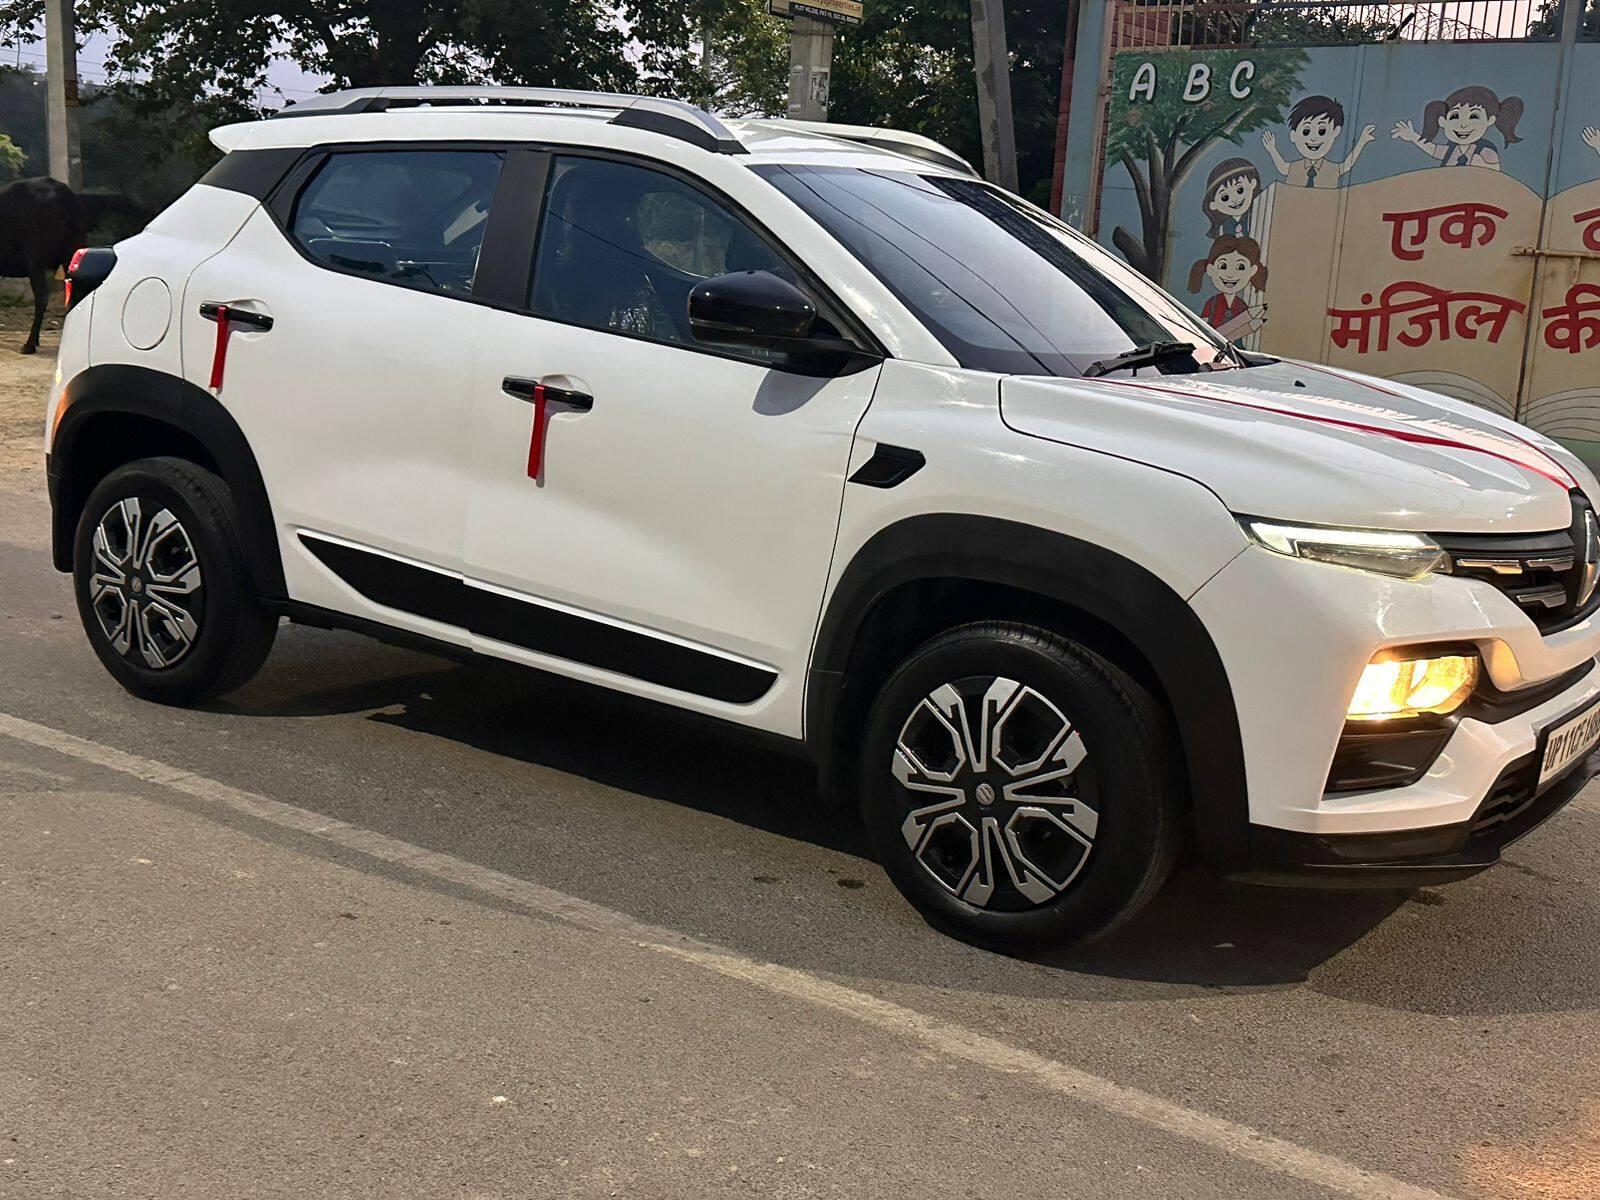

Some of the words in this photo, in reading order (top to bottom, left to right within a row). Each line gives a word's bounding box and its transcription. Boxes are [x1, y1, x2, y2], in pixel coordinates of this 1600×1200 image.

[1129, 62, 1157, 101] A
[1182, 63, 1212, 102] B
[1230, 60, 1255, 99] C
[1382, 203, 1509, 261] एक
[1327, 281, 1527, 354] मंजिल
